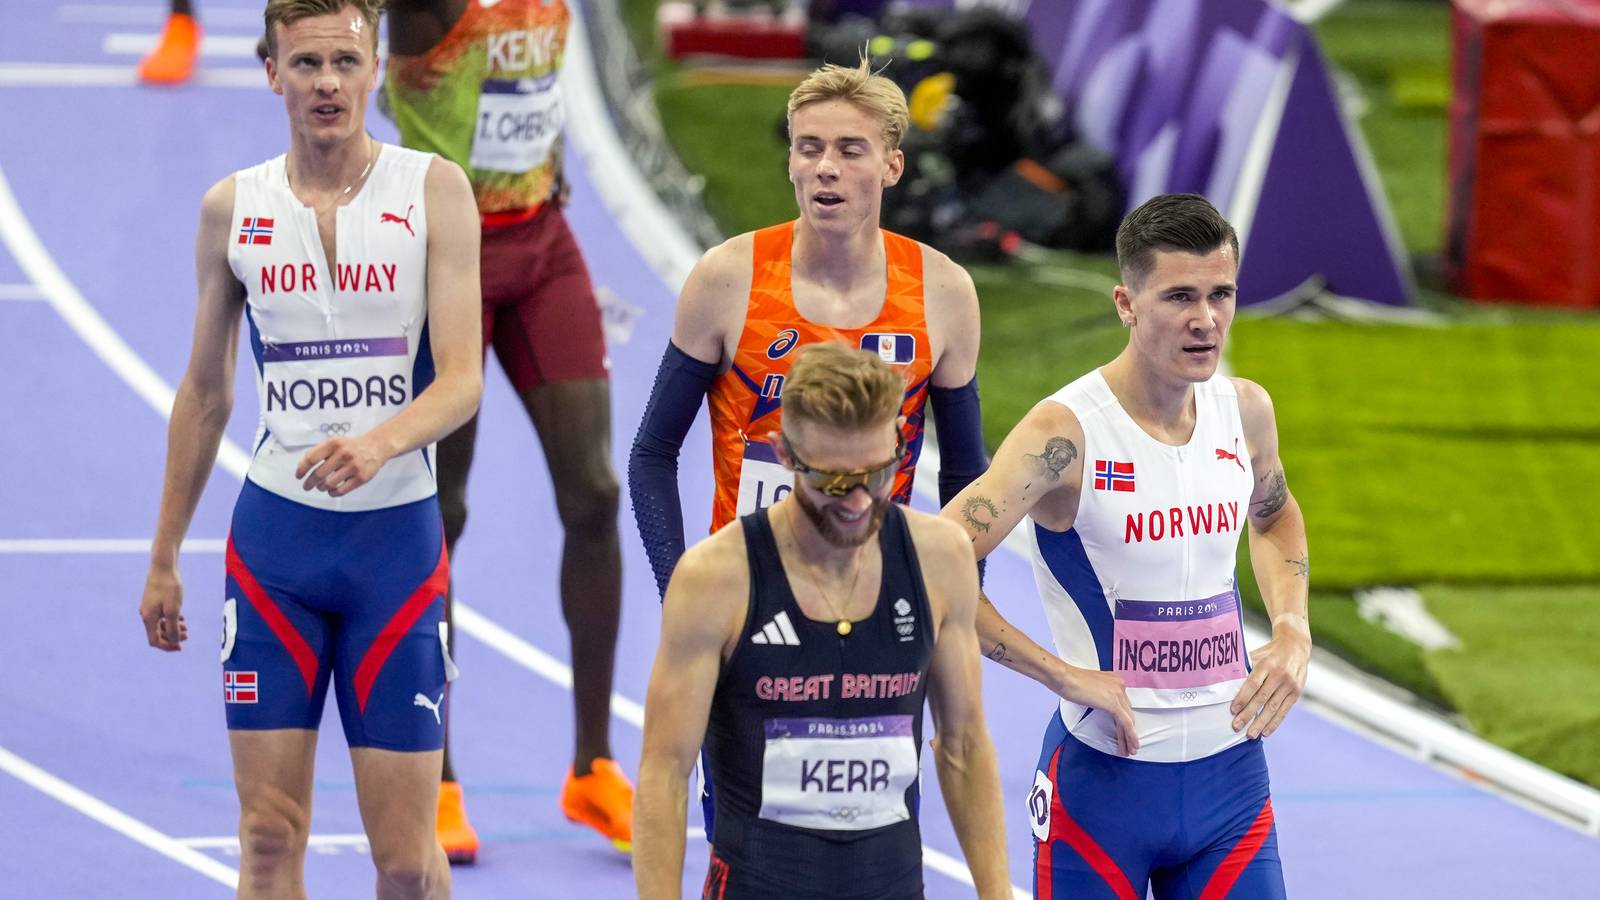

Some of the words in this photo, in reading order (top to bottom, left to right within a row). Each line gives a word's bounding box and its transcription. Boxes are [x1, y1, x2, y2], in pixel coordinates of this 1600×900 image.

[295, 345, 331, 357] PARIS
[334, 342, 370, 355] 2024
[266, 374, 407, 412] NORDAS
[1124, 501, 1239, 544] NORWAY
[1157, 606, 1194, 617] PARIS
[1118, 630, 1239, 673] INGEBRIGTSEN
[755, 673, 834, 701] GREAT
[841, 671, 922, 699] BRITAIN
[808, 722, 847, 736] PARIS
[848, 721, 885, 735] 2024
[800, 759, 891, 793] KERR
[1028, 784, 1048, 826] 10
